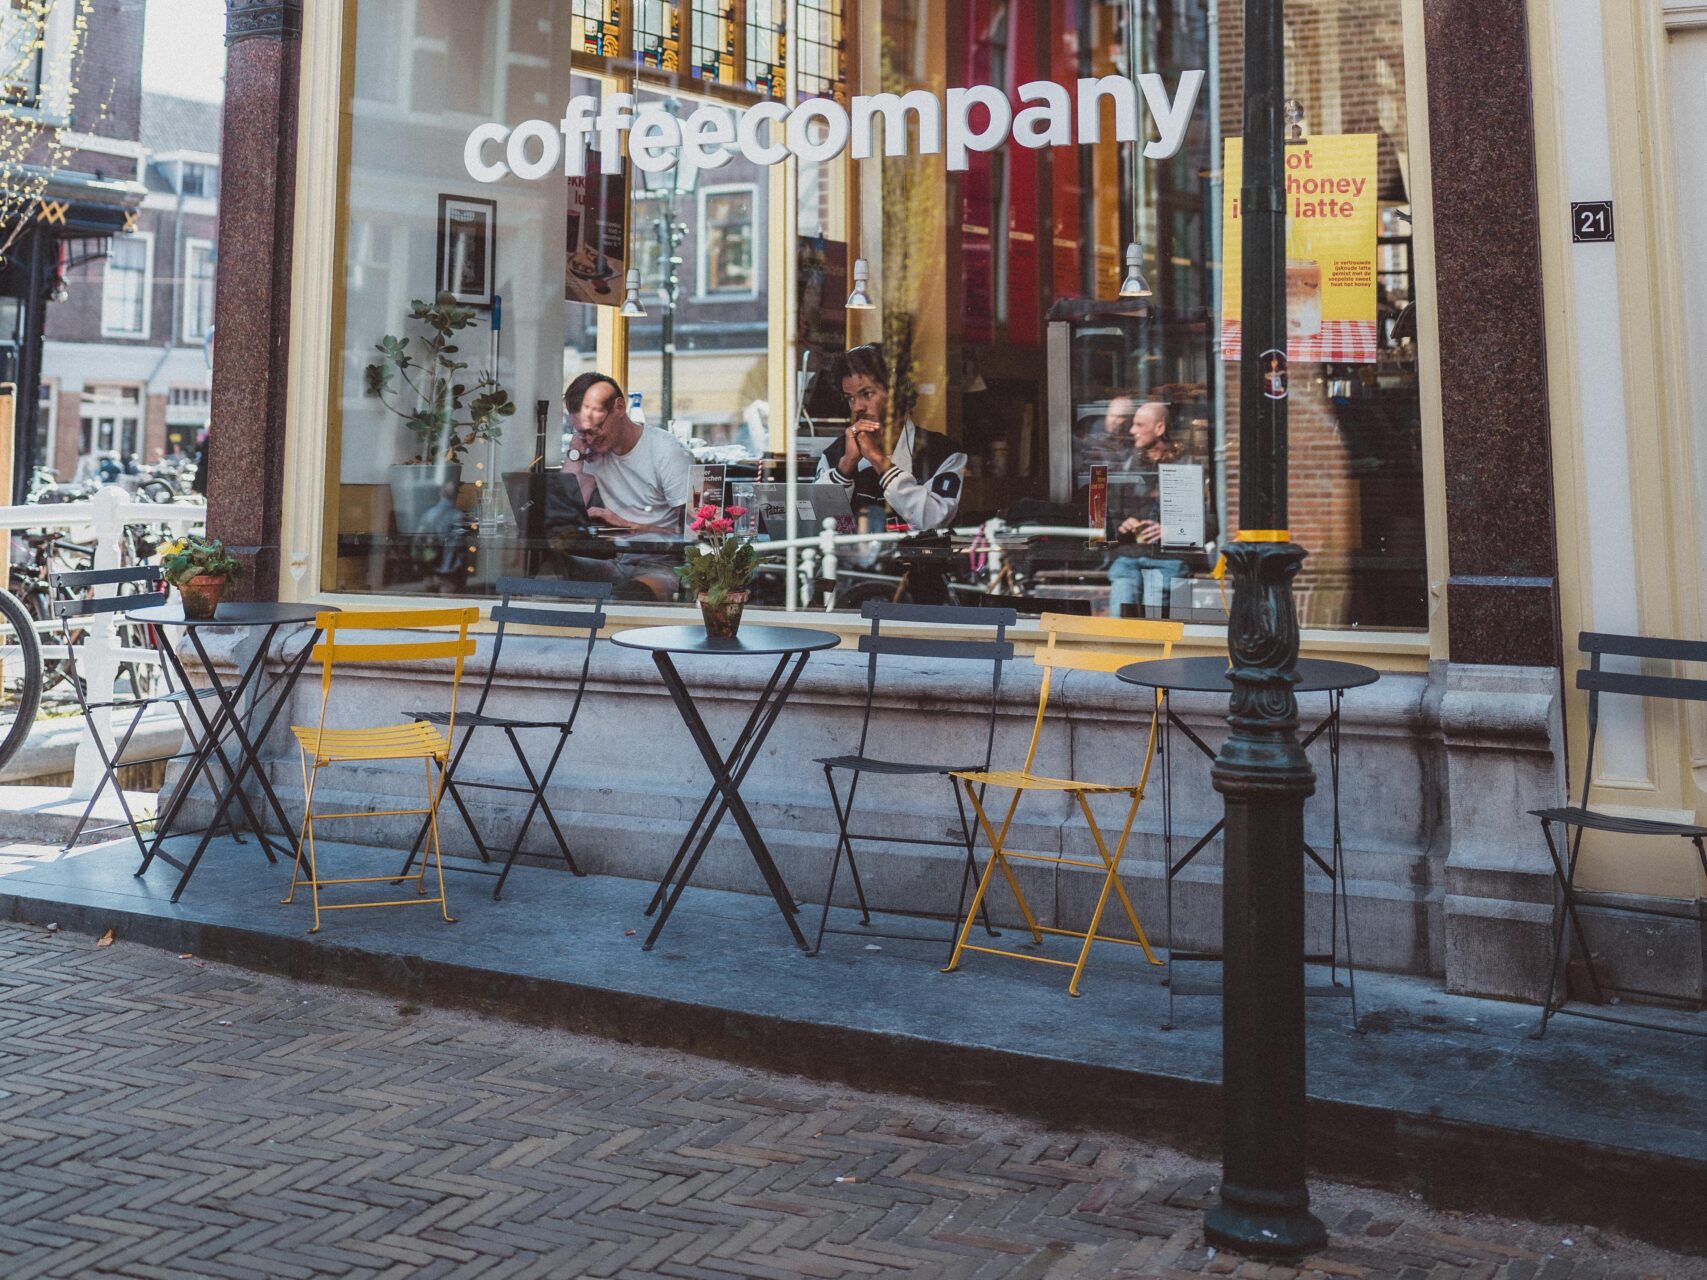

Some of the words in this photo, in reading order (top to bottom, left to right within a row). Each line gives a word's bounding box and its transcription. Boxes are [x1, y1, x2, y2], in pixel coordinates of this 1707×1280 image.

[463, 69, 1206, 183] coffeecompany
[1286, 149, 1313, 169] ot
[1286, 173, 1366, 197] honey
[1295, 197, 1354, 218] latte
[1581, 211, 1605, 232] 21
